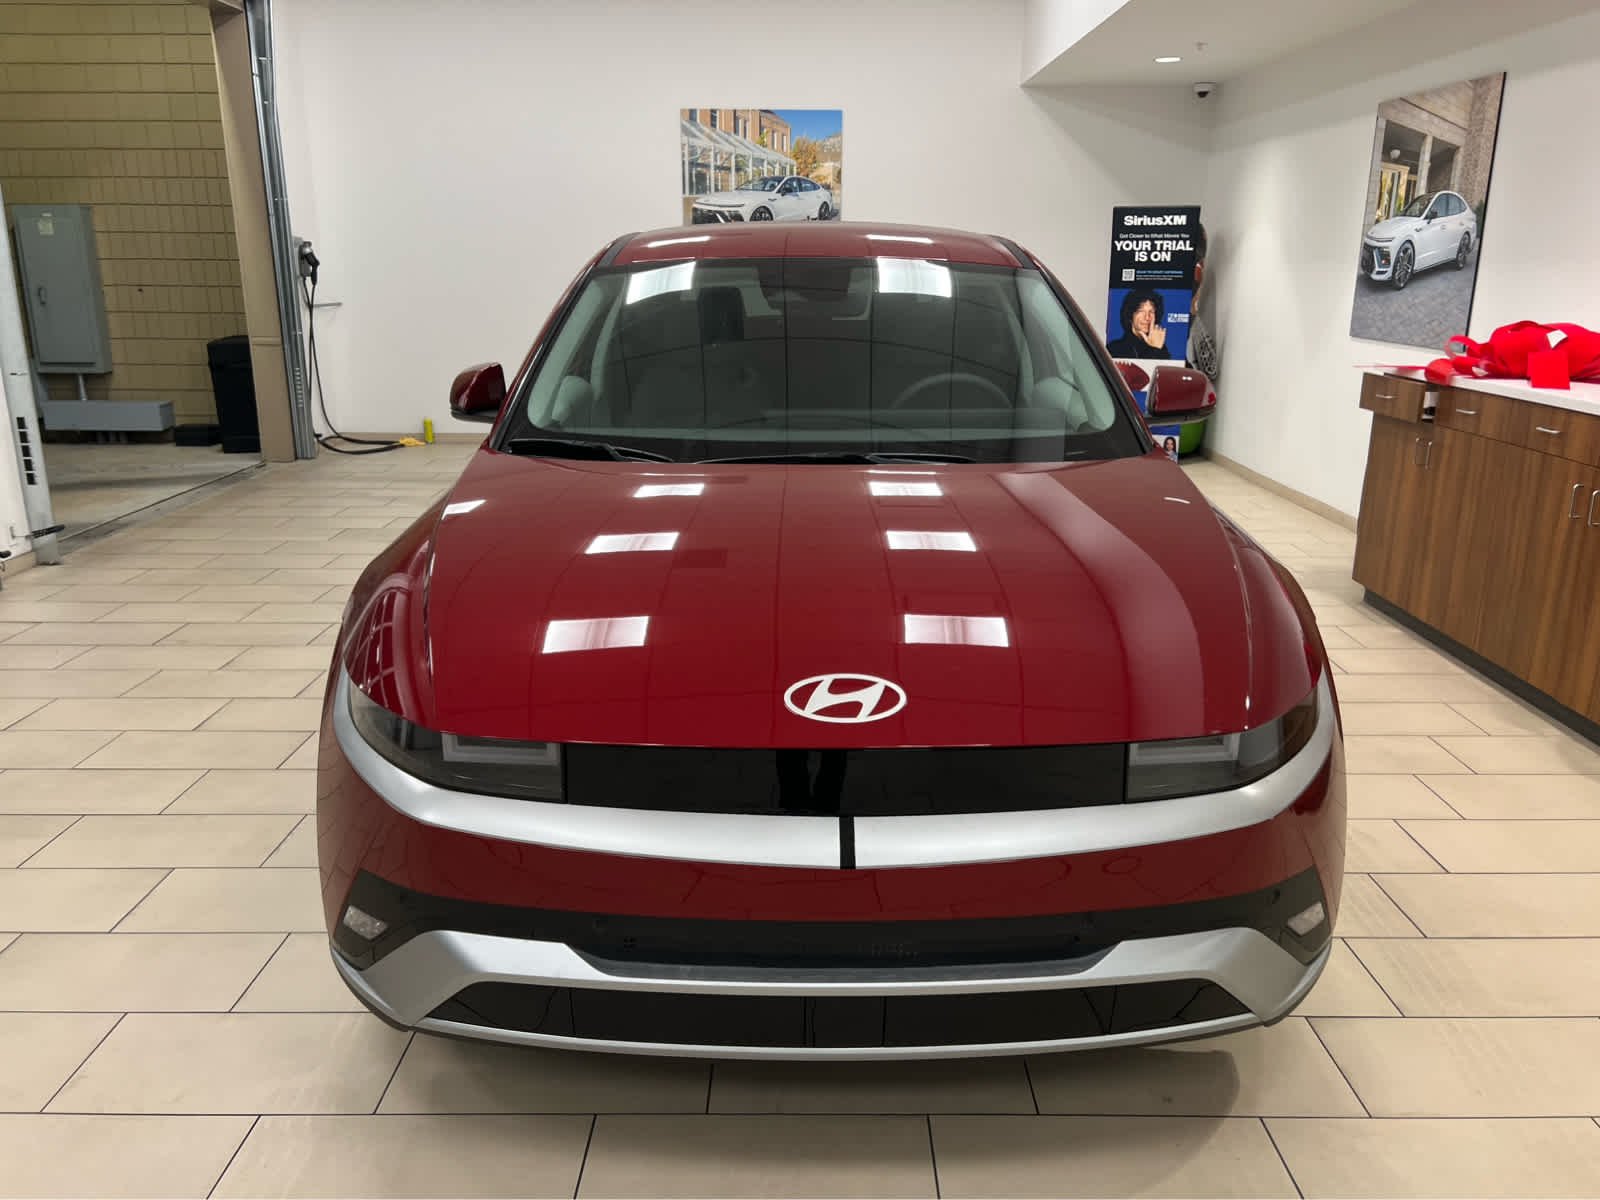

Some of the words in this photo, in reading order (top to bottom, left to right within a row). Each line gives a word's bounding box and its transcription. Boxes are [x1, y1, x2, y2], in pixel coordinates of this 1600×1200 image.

[1124, 215, 1187, 226] SiriusXM
[1114, 240, 1151, 251] YOUR
[1154, 240, 1194, 251] TRIAL
[1135, 251, 1148, 262] IS
[1150, 251, 1172, 262] ON
